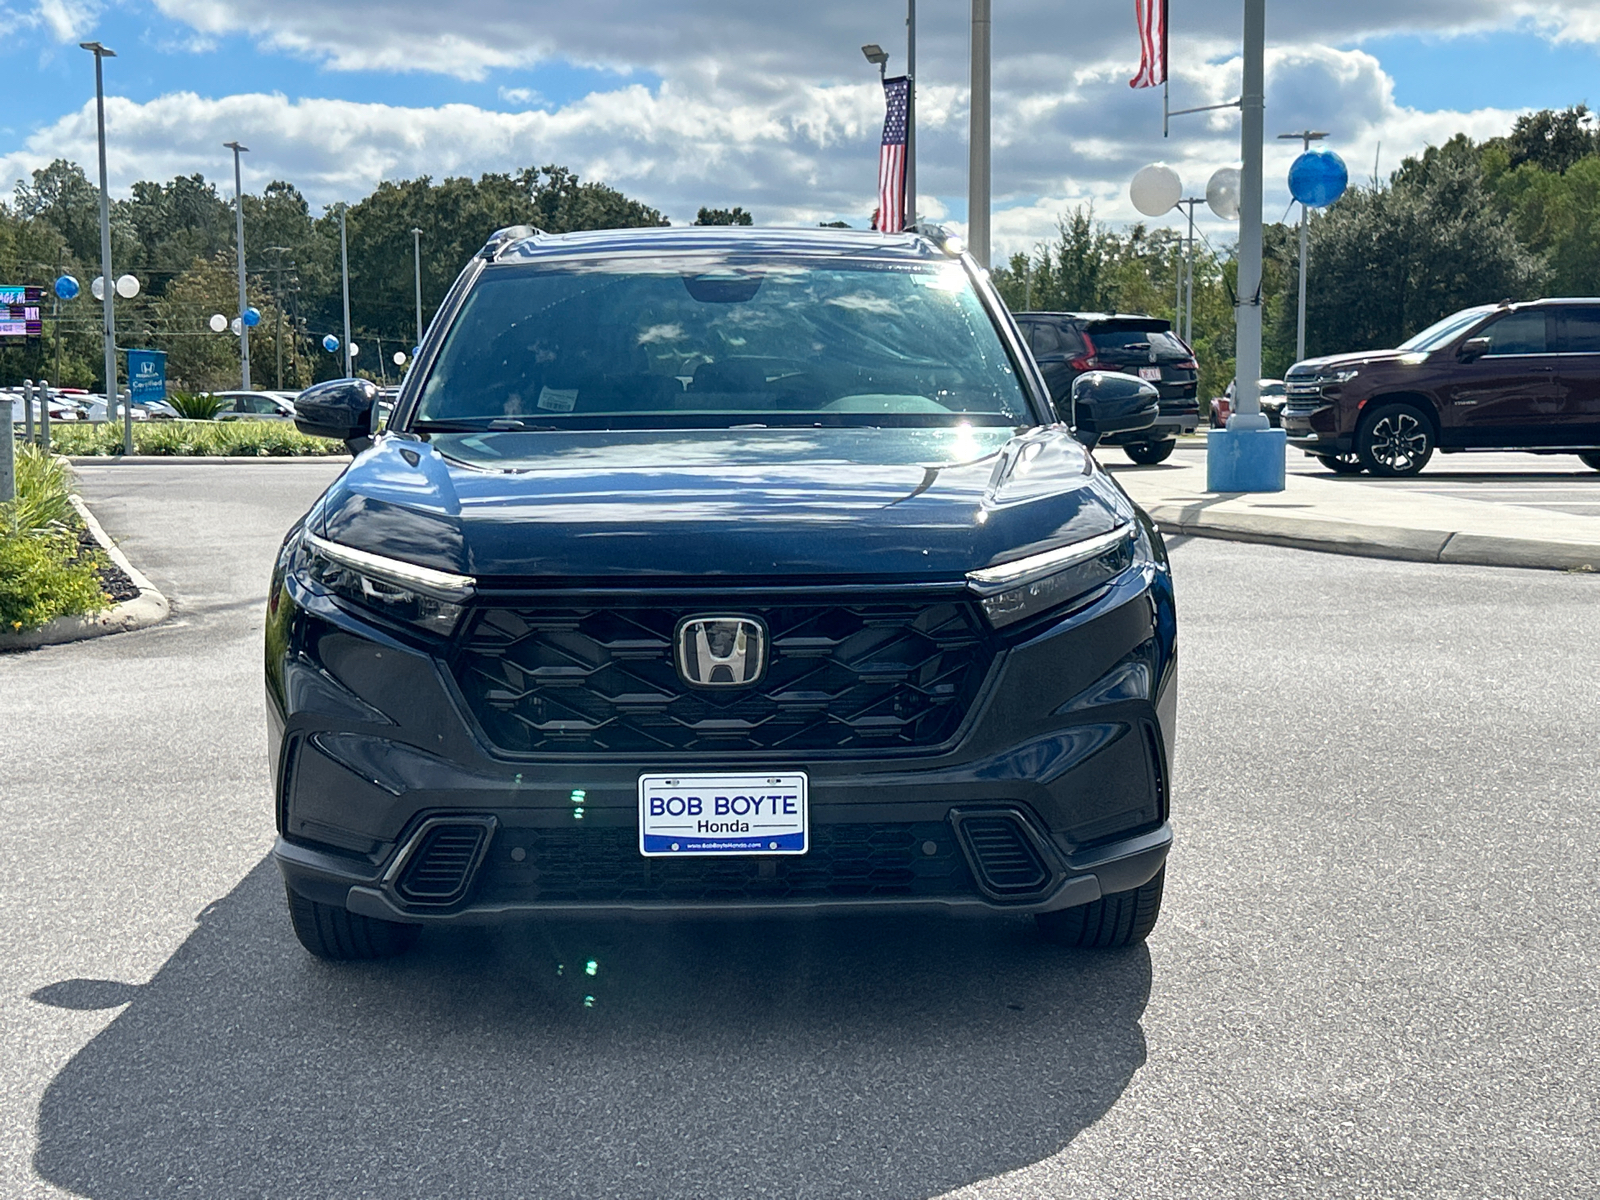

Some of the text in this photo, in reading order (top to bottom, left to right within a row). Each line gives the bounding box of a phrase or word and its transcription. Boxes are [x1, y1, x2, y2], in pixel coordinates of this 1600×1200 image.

[650, 796, 797, 816] BOB BOYTE
[697, 819, 750, 833] Honda
